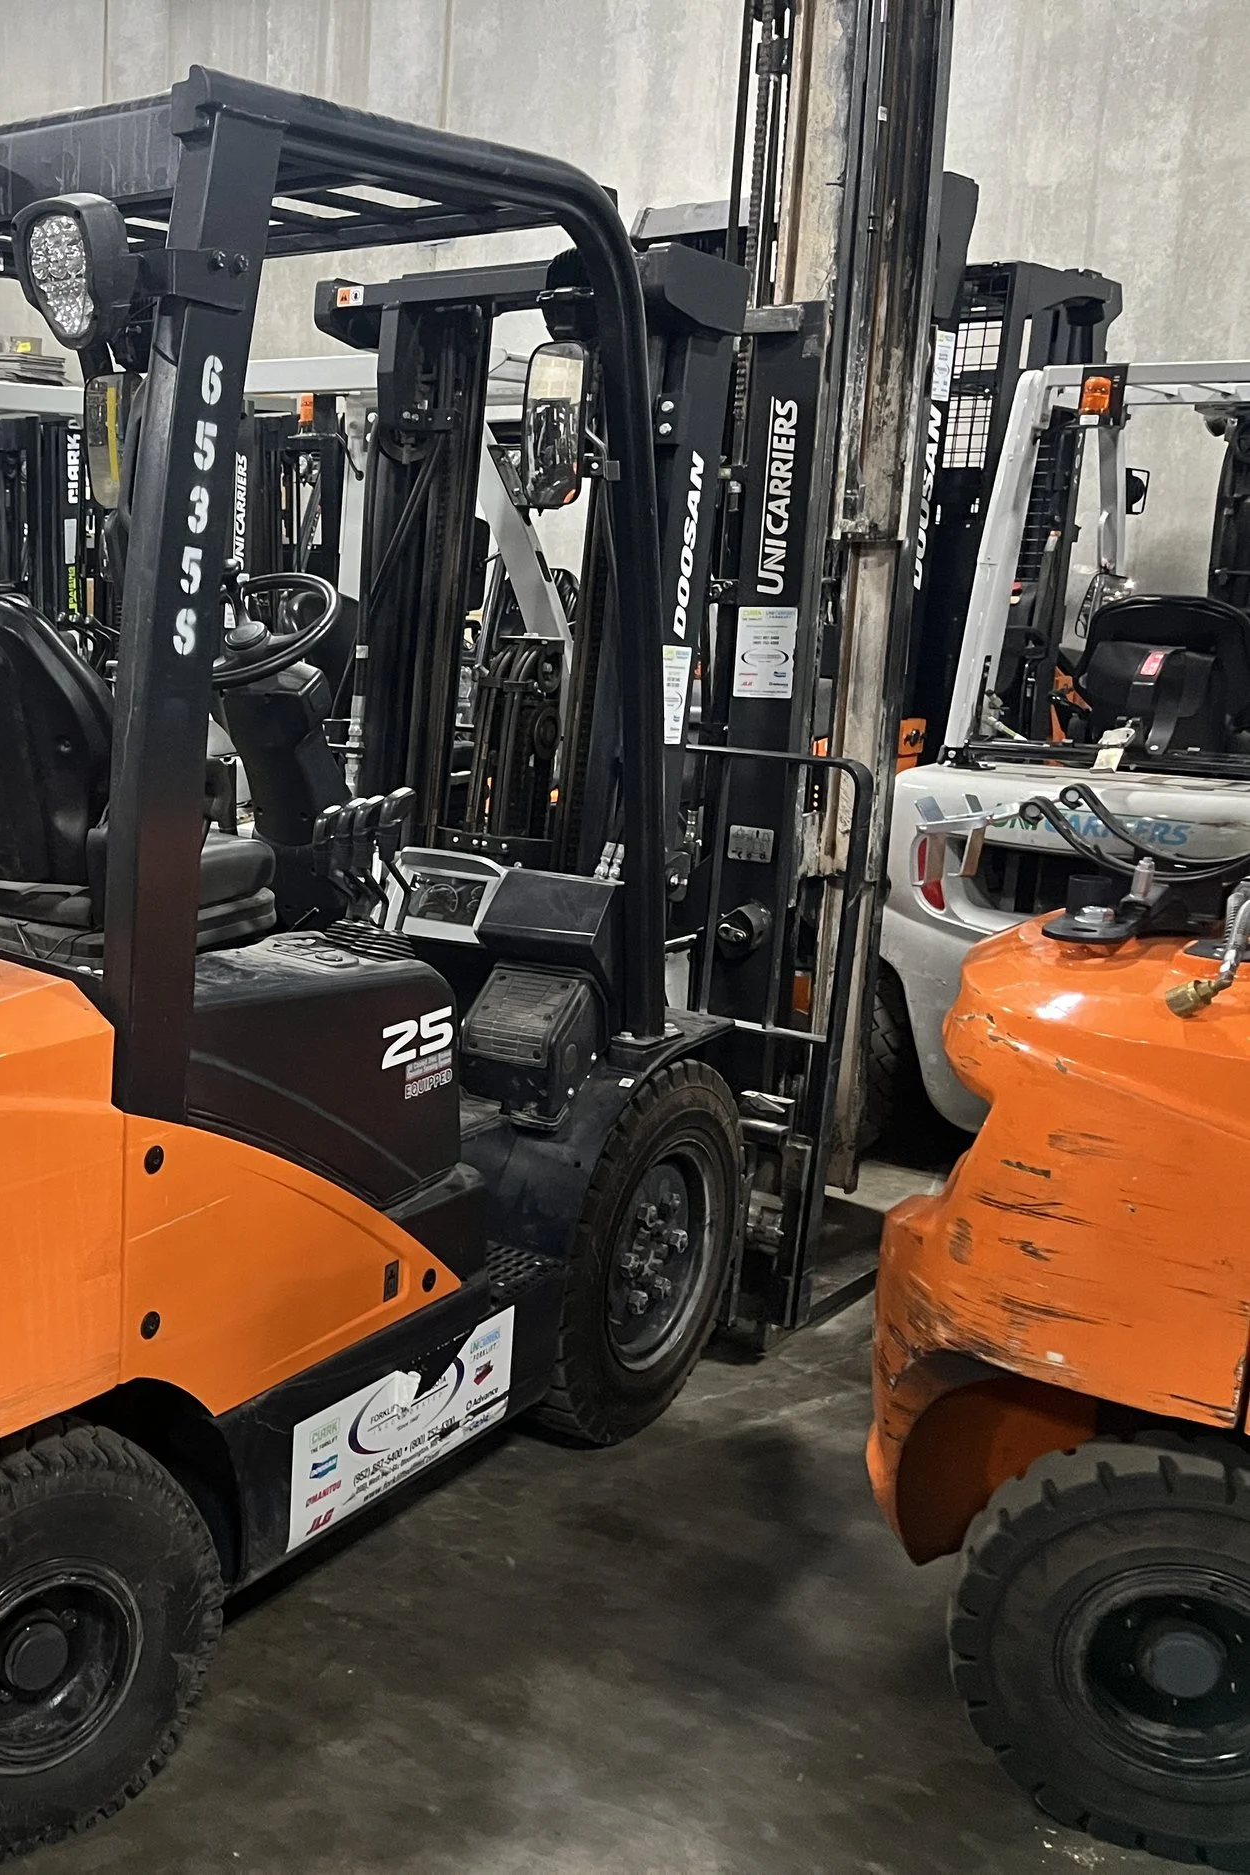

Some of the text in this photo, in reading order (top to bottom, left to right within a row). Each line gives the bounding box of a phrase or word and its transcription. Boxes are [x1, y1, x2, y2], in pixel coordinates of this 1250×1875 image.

[172, 354, 224, 656] 6535S
[756, 395, 799, 596] UNICARRIERS
[673, 450, 705, 640] DOOSAN
[382, 1001, 453, 1070] 25
[404, 1068, 453, 1100] EQUIPPED
[473, 1387, 499, 1406] Advance
[311, 1421, 338, 1444] CLARK
[306, 1507, 335, 1536] JLG
